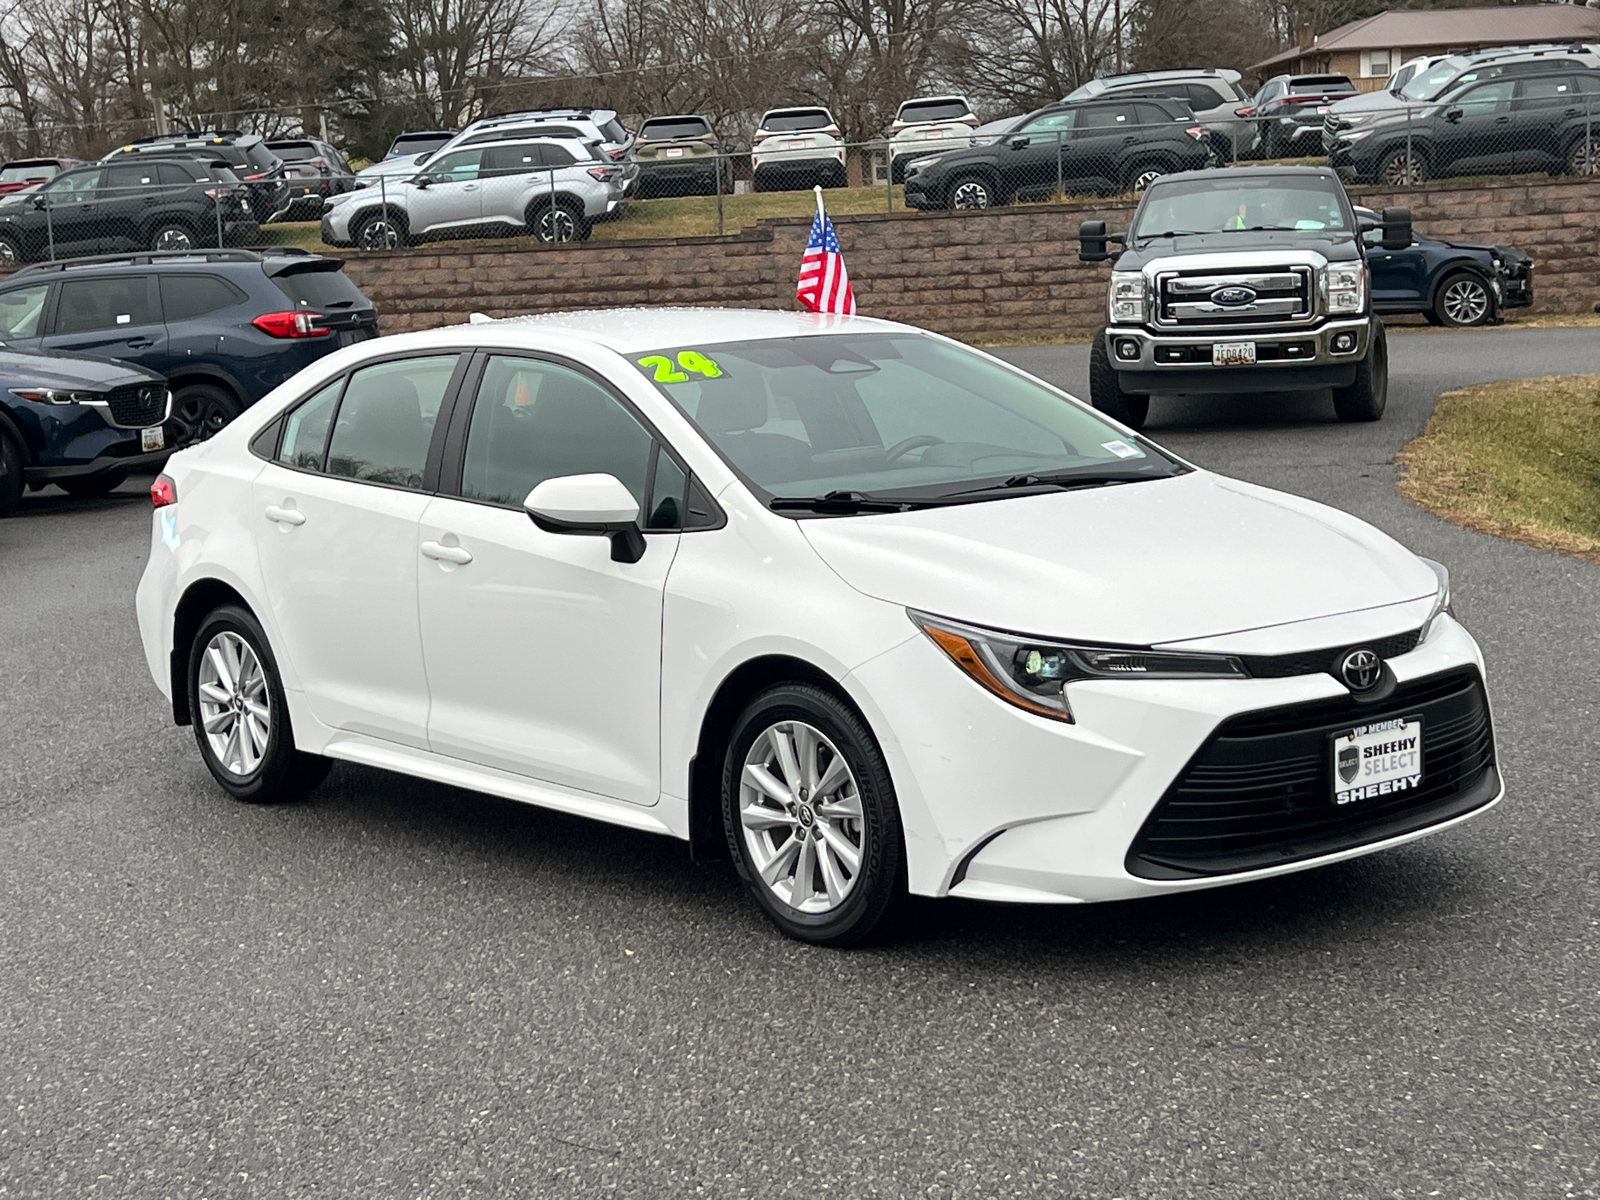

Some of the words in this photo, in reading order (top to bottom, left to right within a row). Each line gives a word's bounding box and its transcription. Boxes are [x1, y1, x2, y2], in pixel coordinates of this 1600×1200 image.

[1220, 290, 1247, 301] Ford
[637, 350, 723, 383] 24
[1353, 726, 1368, 737] VIP
[1368, 718, 1404, 735] MEMBER
[1363, 737, 1417, 759] SHEEHY
[1364, 751, 1417, 776] SELECT
[1336, 774, 1422, 805] SHEEHY
